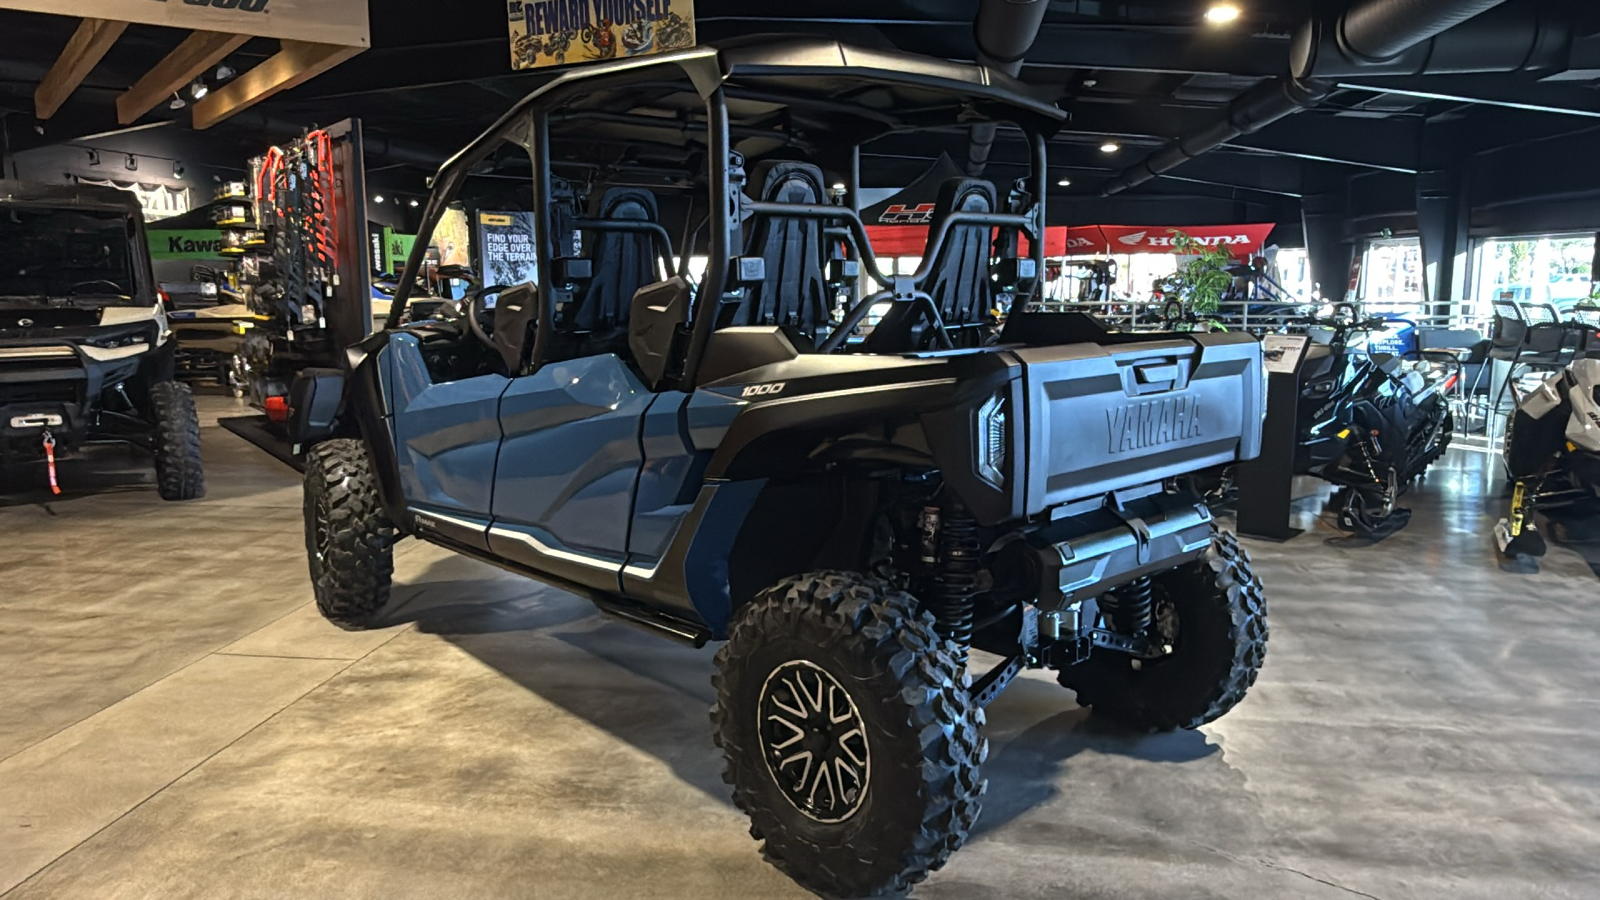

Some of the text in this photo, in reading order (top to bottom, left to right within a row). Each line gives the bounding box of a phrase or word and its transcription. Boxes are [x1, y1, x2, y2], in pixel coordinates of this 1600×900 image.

[524, 0, 592, 36] REWARD
[594, 0, 671, 28] YOURSELF
[486, 232, 529, 243] FIND YOUR
[1147, 234, 1251, 246] HONDA
[487, 242, 532, 253] EDGE OVER
[487, 251, 504, 261] THE
[741, 382, 786, 397] 1000
[1105, 395, 1202, 454] YAMAHA
